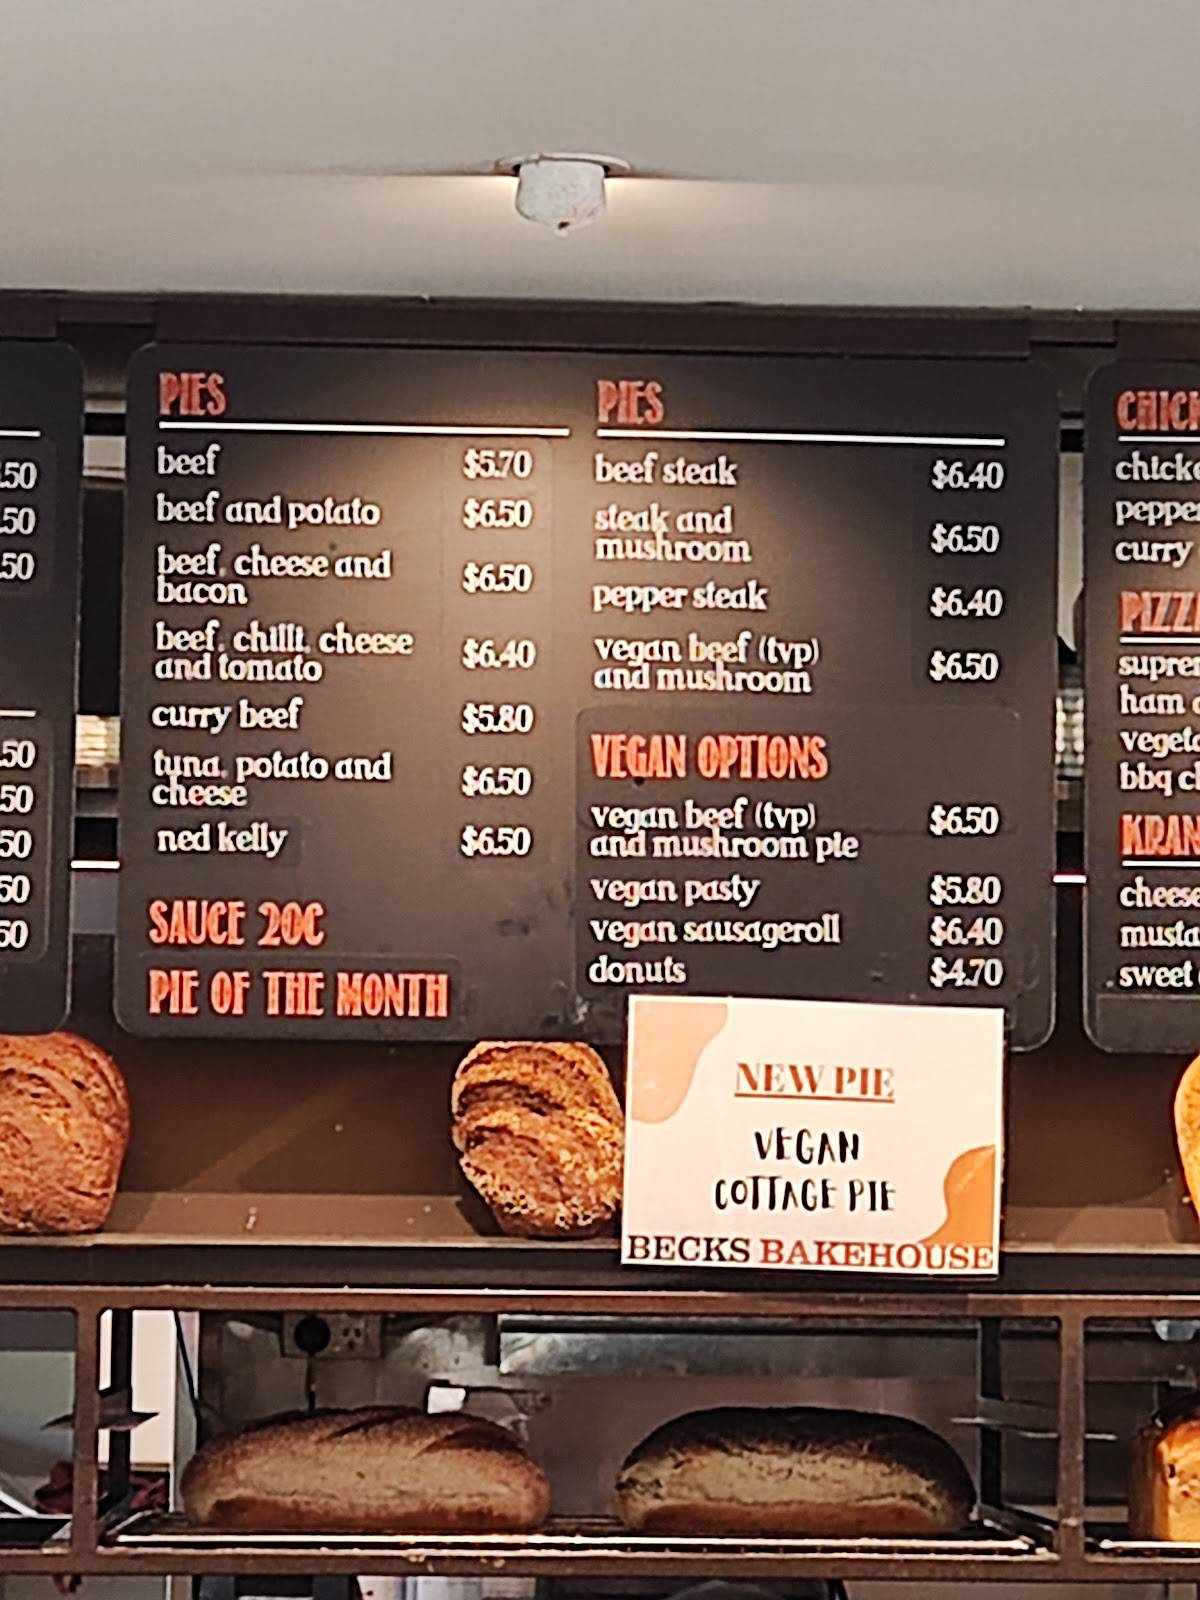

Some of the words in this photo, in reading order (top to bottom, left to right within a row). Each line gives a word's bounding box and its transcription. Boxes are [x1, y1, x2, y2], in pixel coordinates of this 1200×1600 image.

[159, 372, 227, 416] PIES
[597, 380, 664, 424] PIES
[157, 443, 220, 476] beef
[463, 448, 533, 479] $5.70
[595, 453, 657, 485] beef
[663, 455, 738, 486] steak
[931, 460, 1005, 490] $6.40
[157, 491, 219, 522] beef
[225, 496, 281, 524] and
[288, 498, 381, 528] potato
[463, 499, 532, 528] $6.50
[595, 504, 668, 533] steak
[676, 506, 732, 535] and
[1115, 500, 1200, 526] peppe
[595, 532, 752, 562] mushroom
[930, 524, 999, 554] $6.50
[1115, 541, 1195, 568] curry
[234, 544, 329, 577] cheese
[334, 549, 391, 578] and
[157, 574, 248, 604] bacon
[463, 563, 532, 593] $6.50
[593, 583, 687, 612] pepper
[693, 580, 768, 610] steak
[929, 587, 1003, 618] $6.40
[1121, 591, 1200, 632] PIZZ
[319, 621, 414, 654] cheese
[462, 638, 536, 669] $6.40
[594, 638, 681, 666] vegan
[688, 631, 752, 663] beef
[758, 637, 819, 666] (tvp)
[155, 652, 212, 680] and
[218, 653, 322, 681] tomato
[594, 663, 649, 690] and
[656, 661, 812, 693] mushroom
[929, 651, 998, 681] $6.50
[1120, 683, 1186, 714] ham
[152, 704, 231, 734] curry
[239, 697, 303, 730] beef
[462, 703, 534, 733] $5.80
[236, 751, 329, 782] potato
[334, 752, 392, 781] and
[590, 734, 686, 778] VEGAN
[698, 735, 829, 780] OPTIONS
[152, 776, 248, 806] cheese
[461, 765, 531, 796] $6.50
[1120, 762, 1173, 797] bbq
[590, 805, 678, 831] vegan
[685, 798, 749, 830] beef
[755, 802, 816, 831] (tvp)
[929, 805, 999, 835] $6.50
[157, 824, 211, 853] ned
[218, 822, 288, 858] kelly
[461, 825, 531, 857] $6.50
[590, 831, 645, 857] and
[652, 827, 808, 858] mushroom
[816, 833, 859, 862] pie
[590, 879, 678, 908] vegan
[684, 876, 761, 908] pasty
[929, 876, 1001, 905] $5.80
[149, 899, 246, 945] SAUCE
[590, 920, 678, 948] vegan
[683, 914, 840, 949] sausageroll
[929, 917, 1003, 947] $6.40
[589, 956, 687, 984] donuts
[929, 957, 1003, 987] $4.70
[1119, 960, 1194, 987] sweet
[148, 970, 198, 1015] PIE
[210, 971, 250, 1015] OF
[262, 972, 325, 1017] THE
[336, 973, 449, 1018] MONTH
[735, 1062, 825, 1095] NEW
[835, 1066, 896, 1098] PIE
[754, 1127, 859, 1164] VEGAN
[715, 1175, 837, 1211] COTTAGE
[849, 1178, 895, 1212] PIE
[627, 1235, 750, 1263] BECKS
[760, 1239, 993, 1269] BAKEHOUSE
